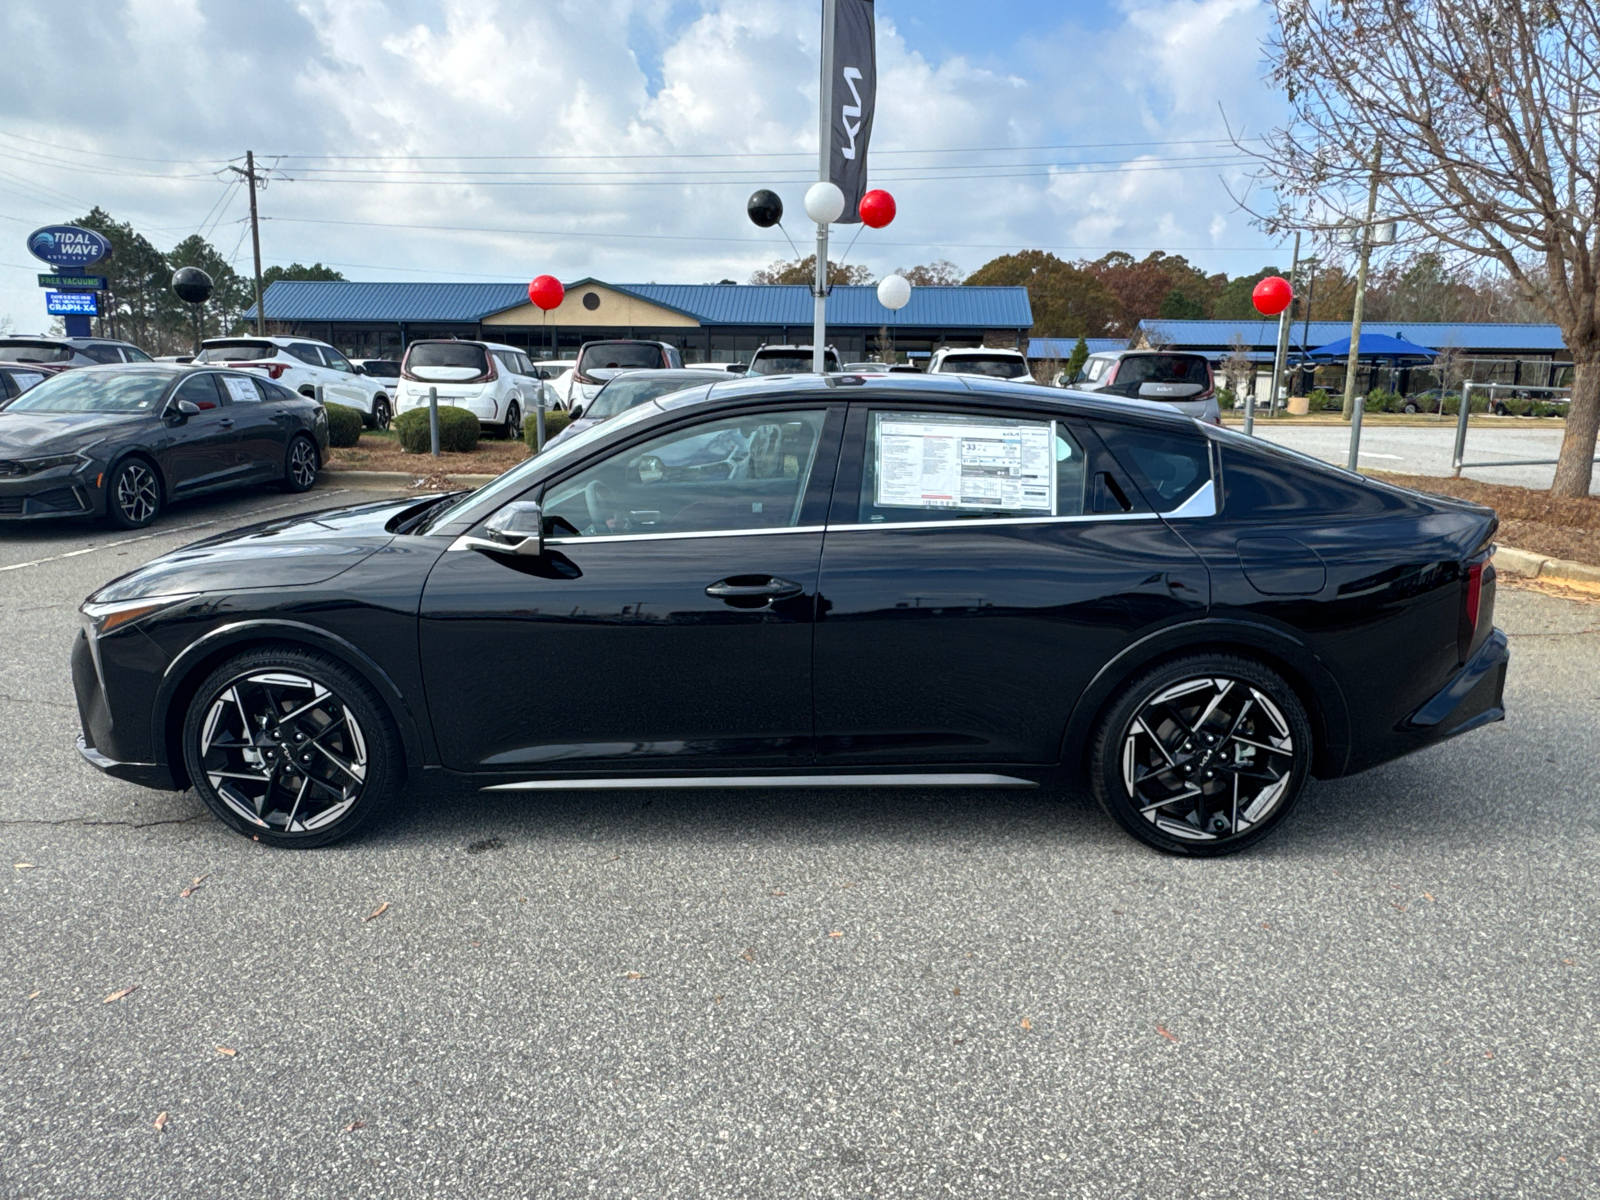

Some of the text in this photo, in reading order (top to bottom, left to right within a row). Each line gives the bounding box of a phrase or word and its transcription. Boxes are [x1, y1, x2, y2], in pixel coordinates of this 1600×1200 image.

[54, 233, 90, 244] TIDAL
[61, 244, 98, 255] WAVE
[62, 278, 99, 286] VACUUMS
